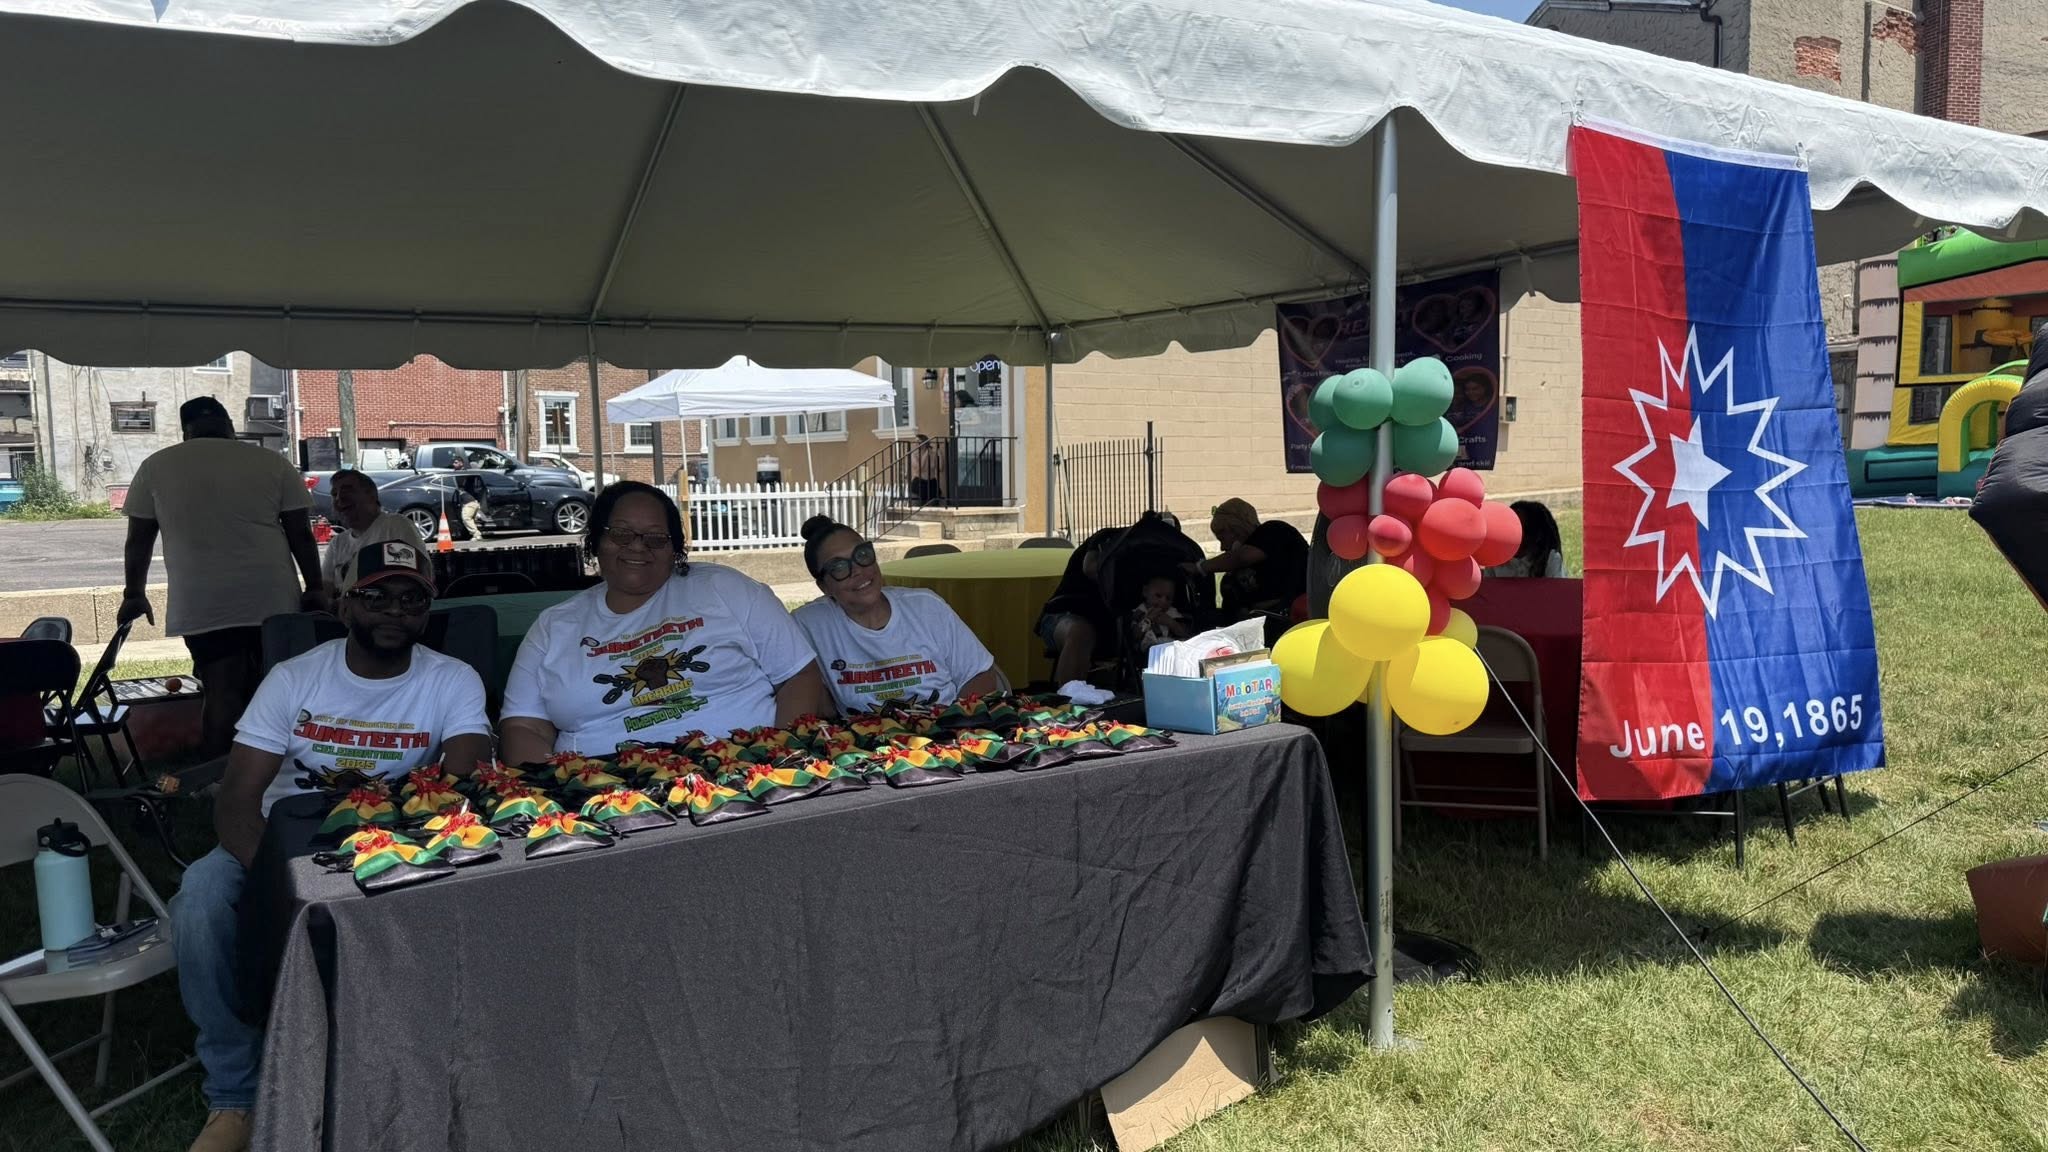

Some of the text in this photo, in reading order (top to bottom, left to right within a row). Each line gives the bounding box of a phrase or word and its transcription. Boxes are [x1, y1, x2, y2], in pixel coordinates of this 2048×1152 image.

[1445, 352, 1482, 363] Cooking
[587, 617, 704, 658] JUNETEETH
[837, 660, 937, 684] JUNETEETH
[630, 679, 695, 707] BREAKING
[624, 708, 668, 733] Powered
[1609, 694, 1863, 759] June 19,1865
[293, 722, 430, 749] JUNETEETH
[312, 743, 404, 760] CELEBRATION
[335, 757, 377, 770] 2025
